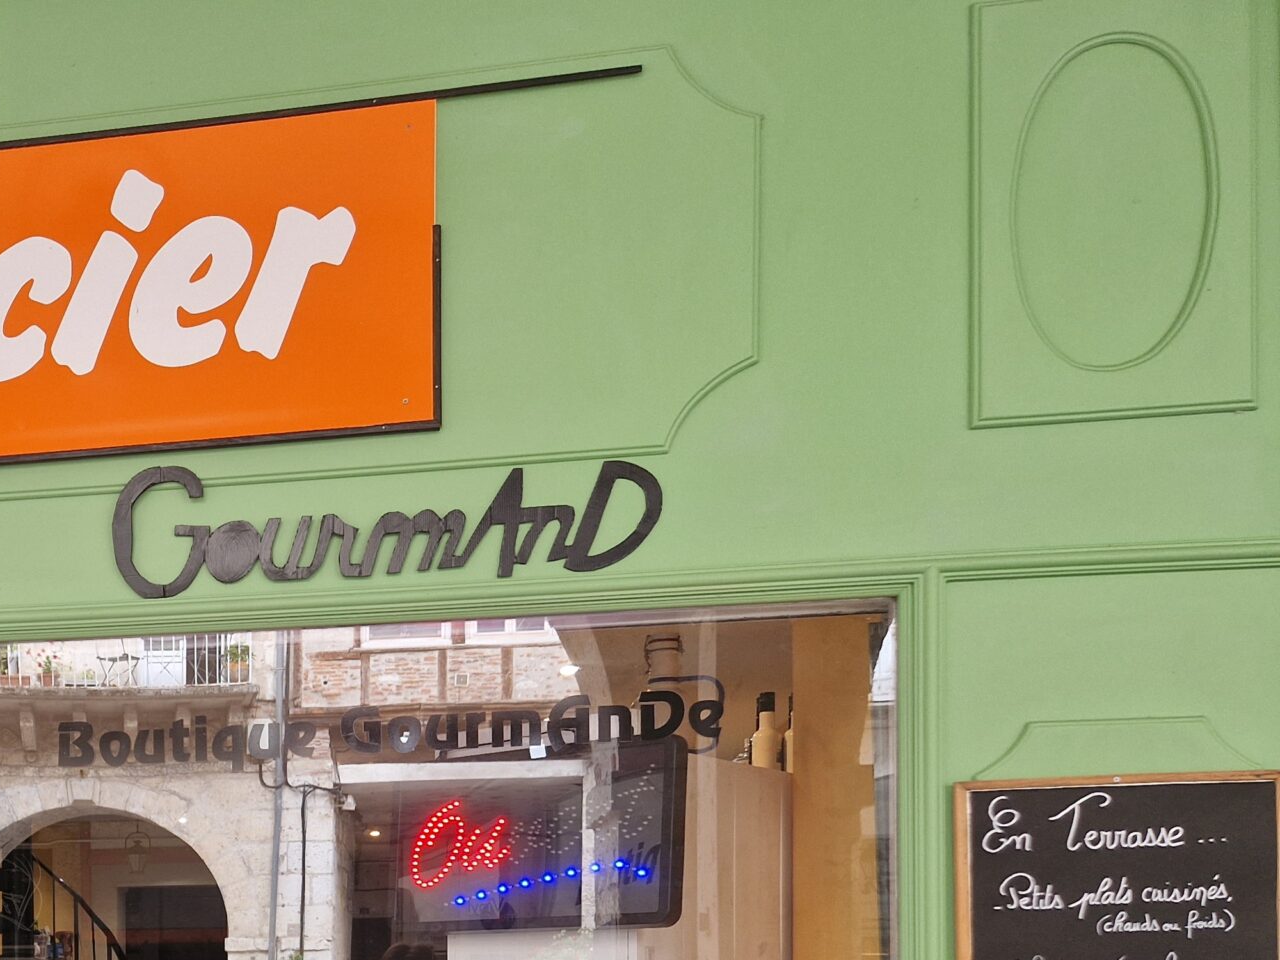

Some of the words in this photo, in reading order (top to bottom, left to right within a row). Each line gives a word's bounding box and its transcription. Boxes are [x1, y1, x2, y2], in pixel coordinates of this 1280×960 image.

[58, 714, 318, 772] Boutique
[982, 796, 1032, 852] En
[1048, 792, 1186, 851] Terrasse
[1069, 876, 1133, 919] plats
[1162, 920, 1181, 932] ou
